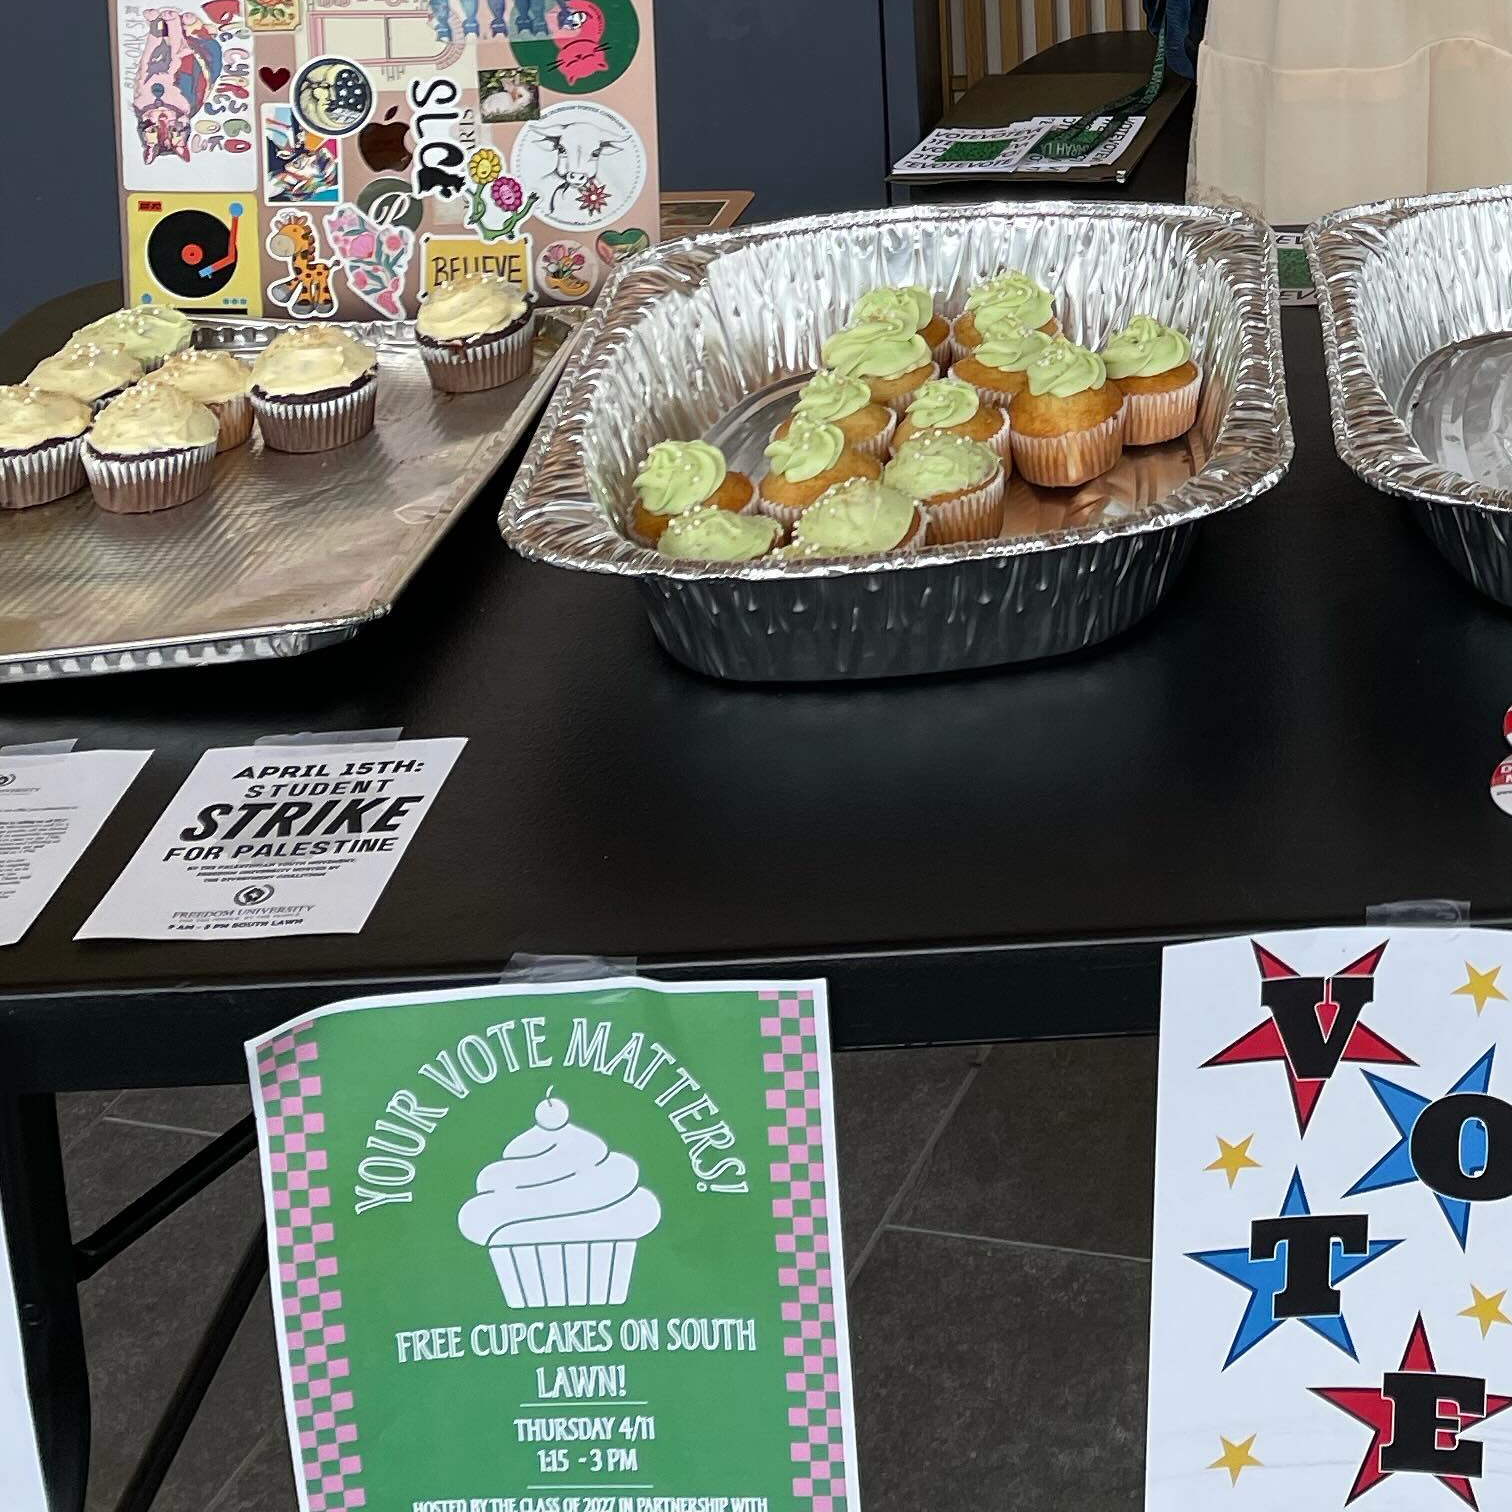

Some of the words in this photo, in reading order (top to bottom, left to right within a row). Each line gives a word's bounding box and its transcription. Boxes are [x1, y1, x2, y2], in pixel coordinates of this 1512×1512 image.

[232, 763, 334, 780] APRIL
[339, 759, 425, 776] 15TH:
[244, 779, 395, 799] STUDENT
[180, 795, 425, 842] STRIKE
[162, 846, 225, 862] FOR
[231, 836, 399, 859] PALESTINE
[172, 910, 235, 919] FREEDOM
[238, 904, 316, 917] UNIVERSITY
[355, 1089, 449, 1215] YOUR
[418, 1017, 553, 1100] VOTE
[563, 1018, 749, 1195] MATTERS!
[395, 1327, 465, 1364] FREE
[470, 1320, 613, 1355] CUPCAKES
[620, 1319, 660, 1352] ON
[666, 1318, 757, 1352] SOUTH
[536, 1365, 627, 1400] LAWN!
[513, 1417, 615, 1443] THURSDAY
[618, 1416, 656, 1441] 4/11
[537, 1450, 570, 1473] 1:15
[591, 1450, 603, 1472] 3
[606, 1448, 638, 1472] PM
